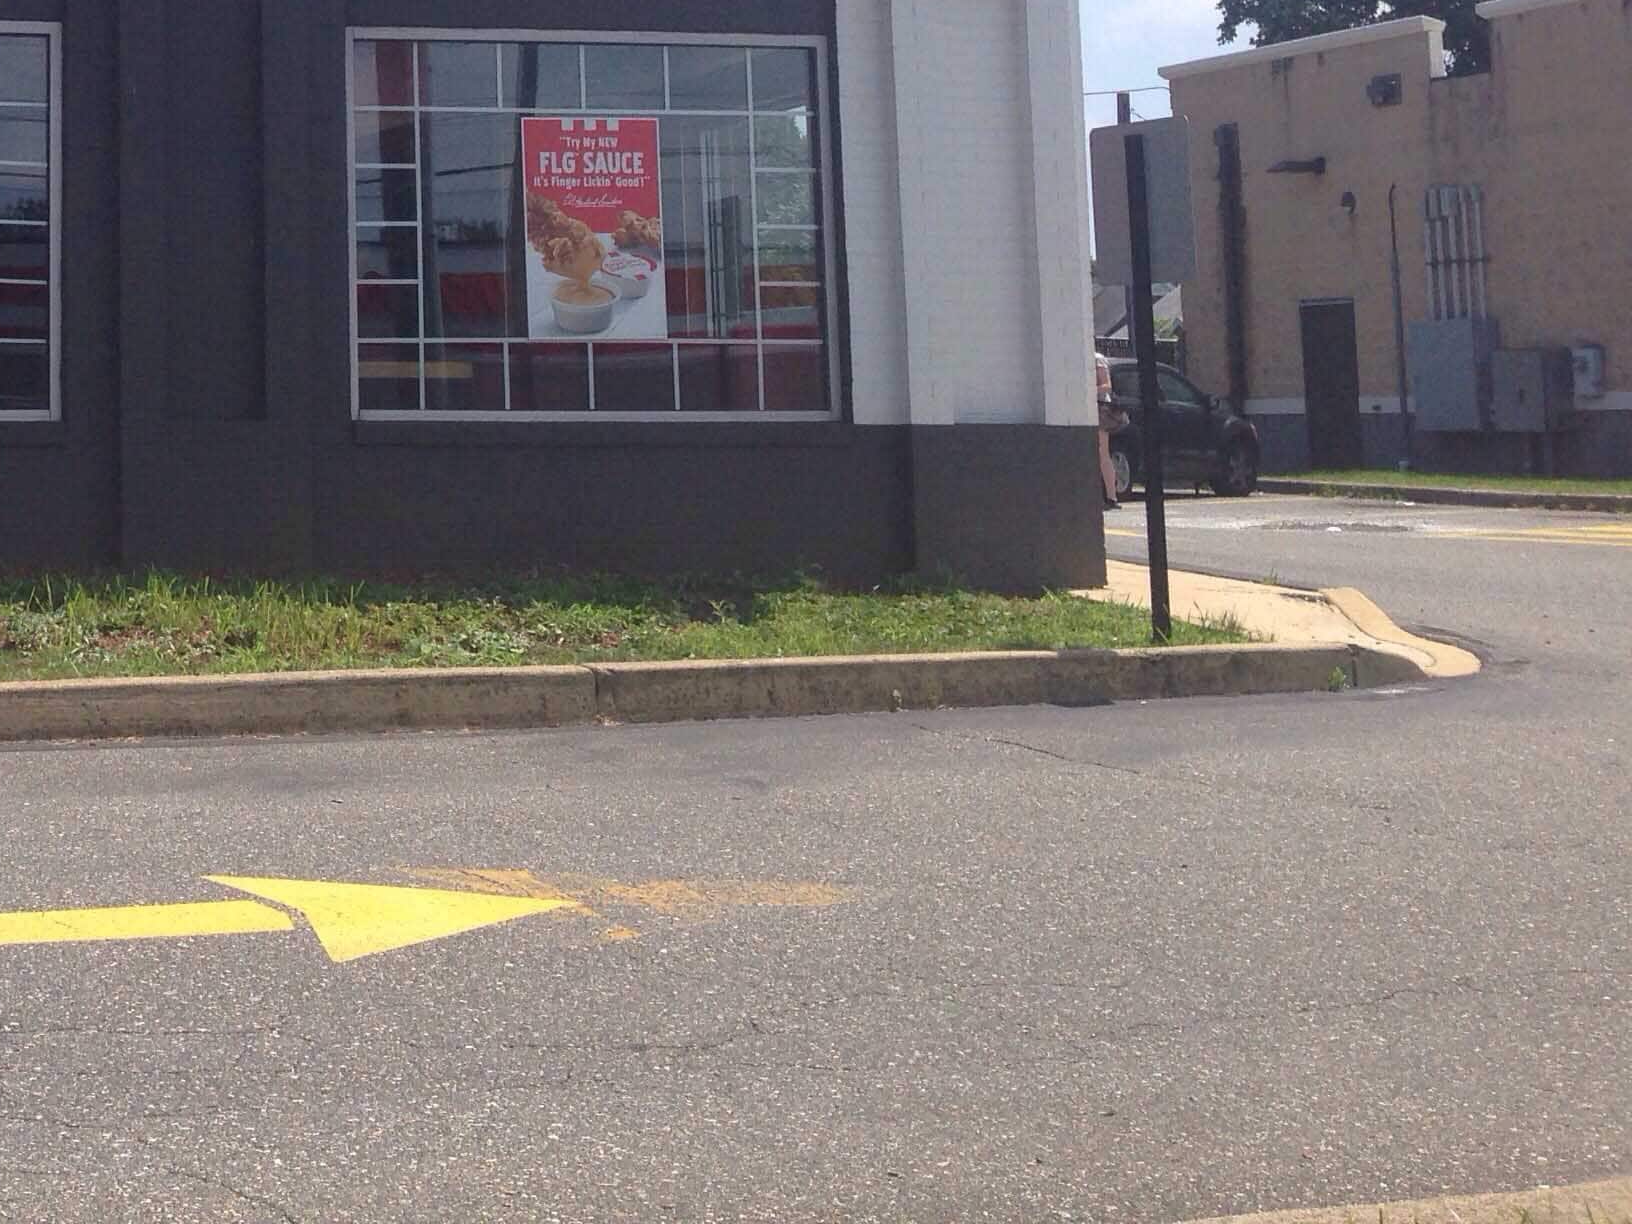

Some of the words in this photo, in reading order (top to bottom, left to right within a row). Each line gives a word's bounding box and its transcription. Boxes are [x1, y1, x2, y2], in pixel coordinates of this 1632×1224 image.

[583, 137, 596, 150] My
[598, 137, 618, 148] NEW
[539, 151, 576, 174] FLG
[583, 151, 645, 174] SAUCE
[533, 176, 549, 187] It's
[551, 176, 581, 190] Finger
[583, 176, 614, 187] Lickin'
